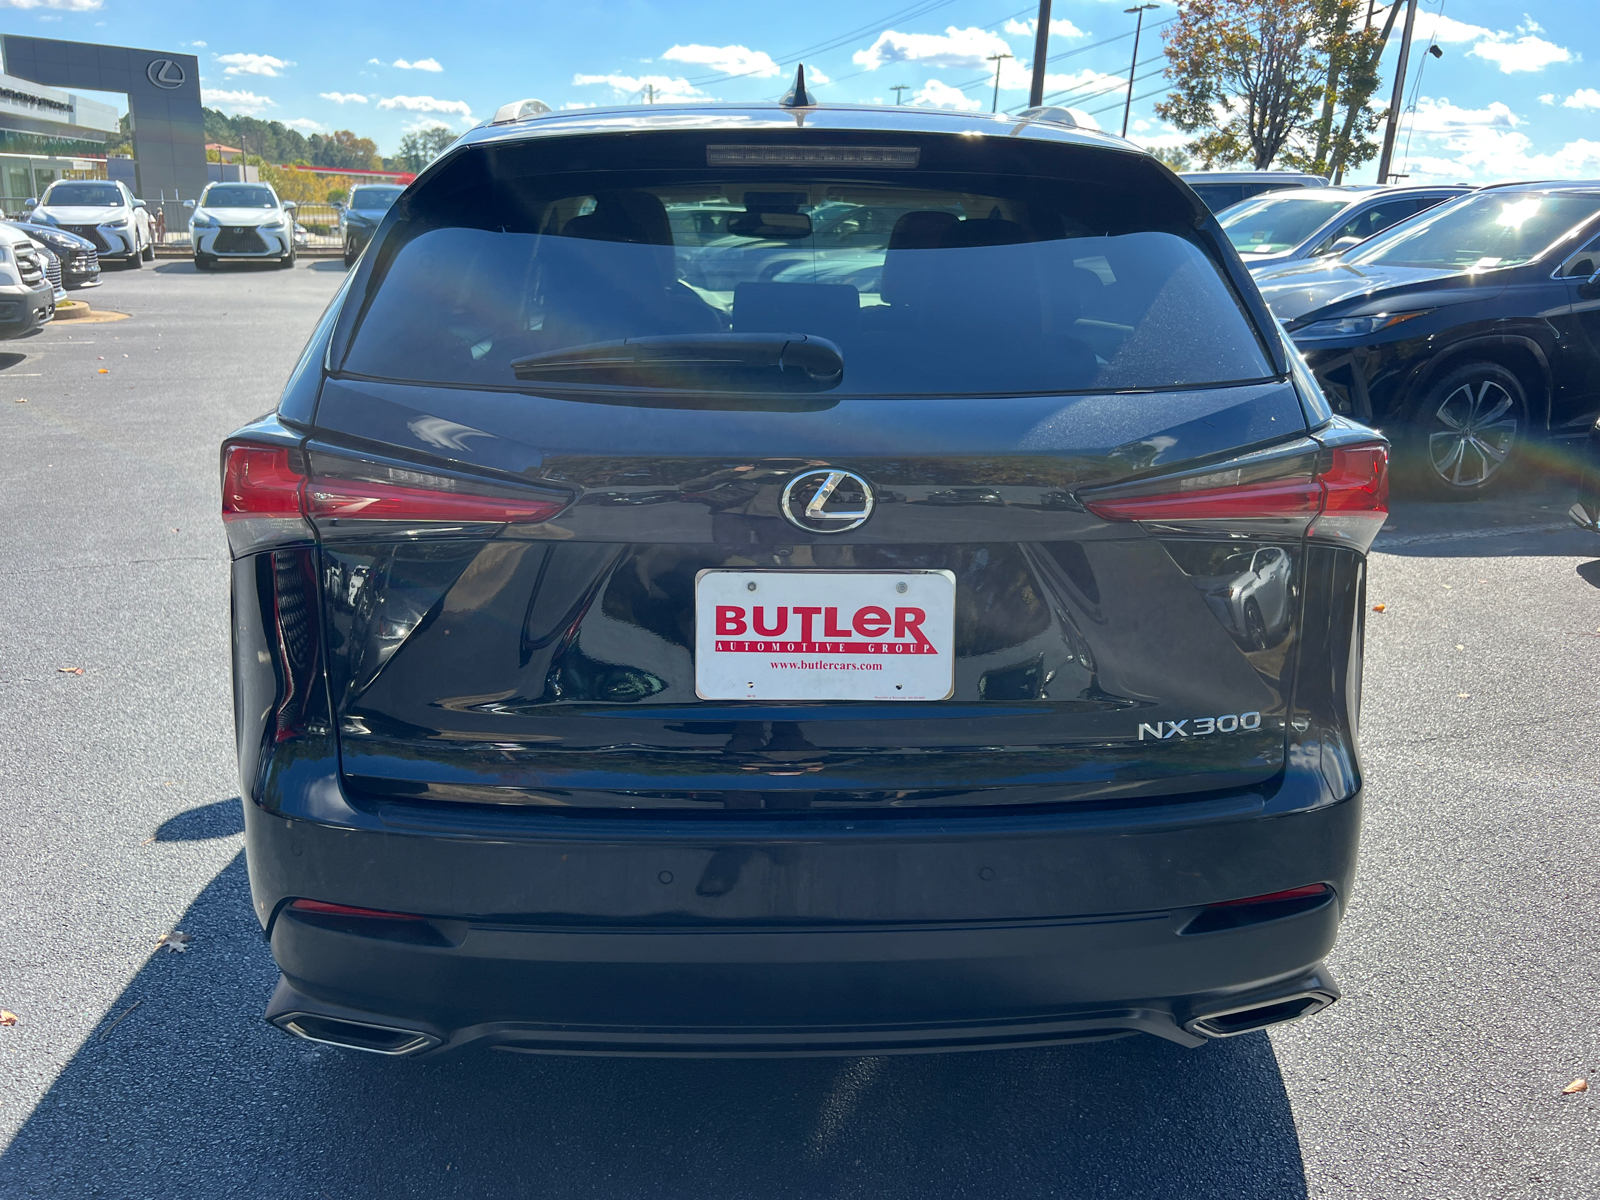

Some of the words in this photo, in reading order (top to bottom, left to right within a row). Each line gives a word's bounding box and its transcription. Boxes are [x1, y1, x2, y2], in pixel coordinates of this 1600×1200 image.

[716, 641, 846, 653] AUTOMOTIVE
[867, 643, 931, 653] GROUP
[770, 660, 883, 671] www.butlercars.com
